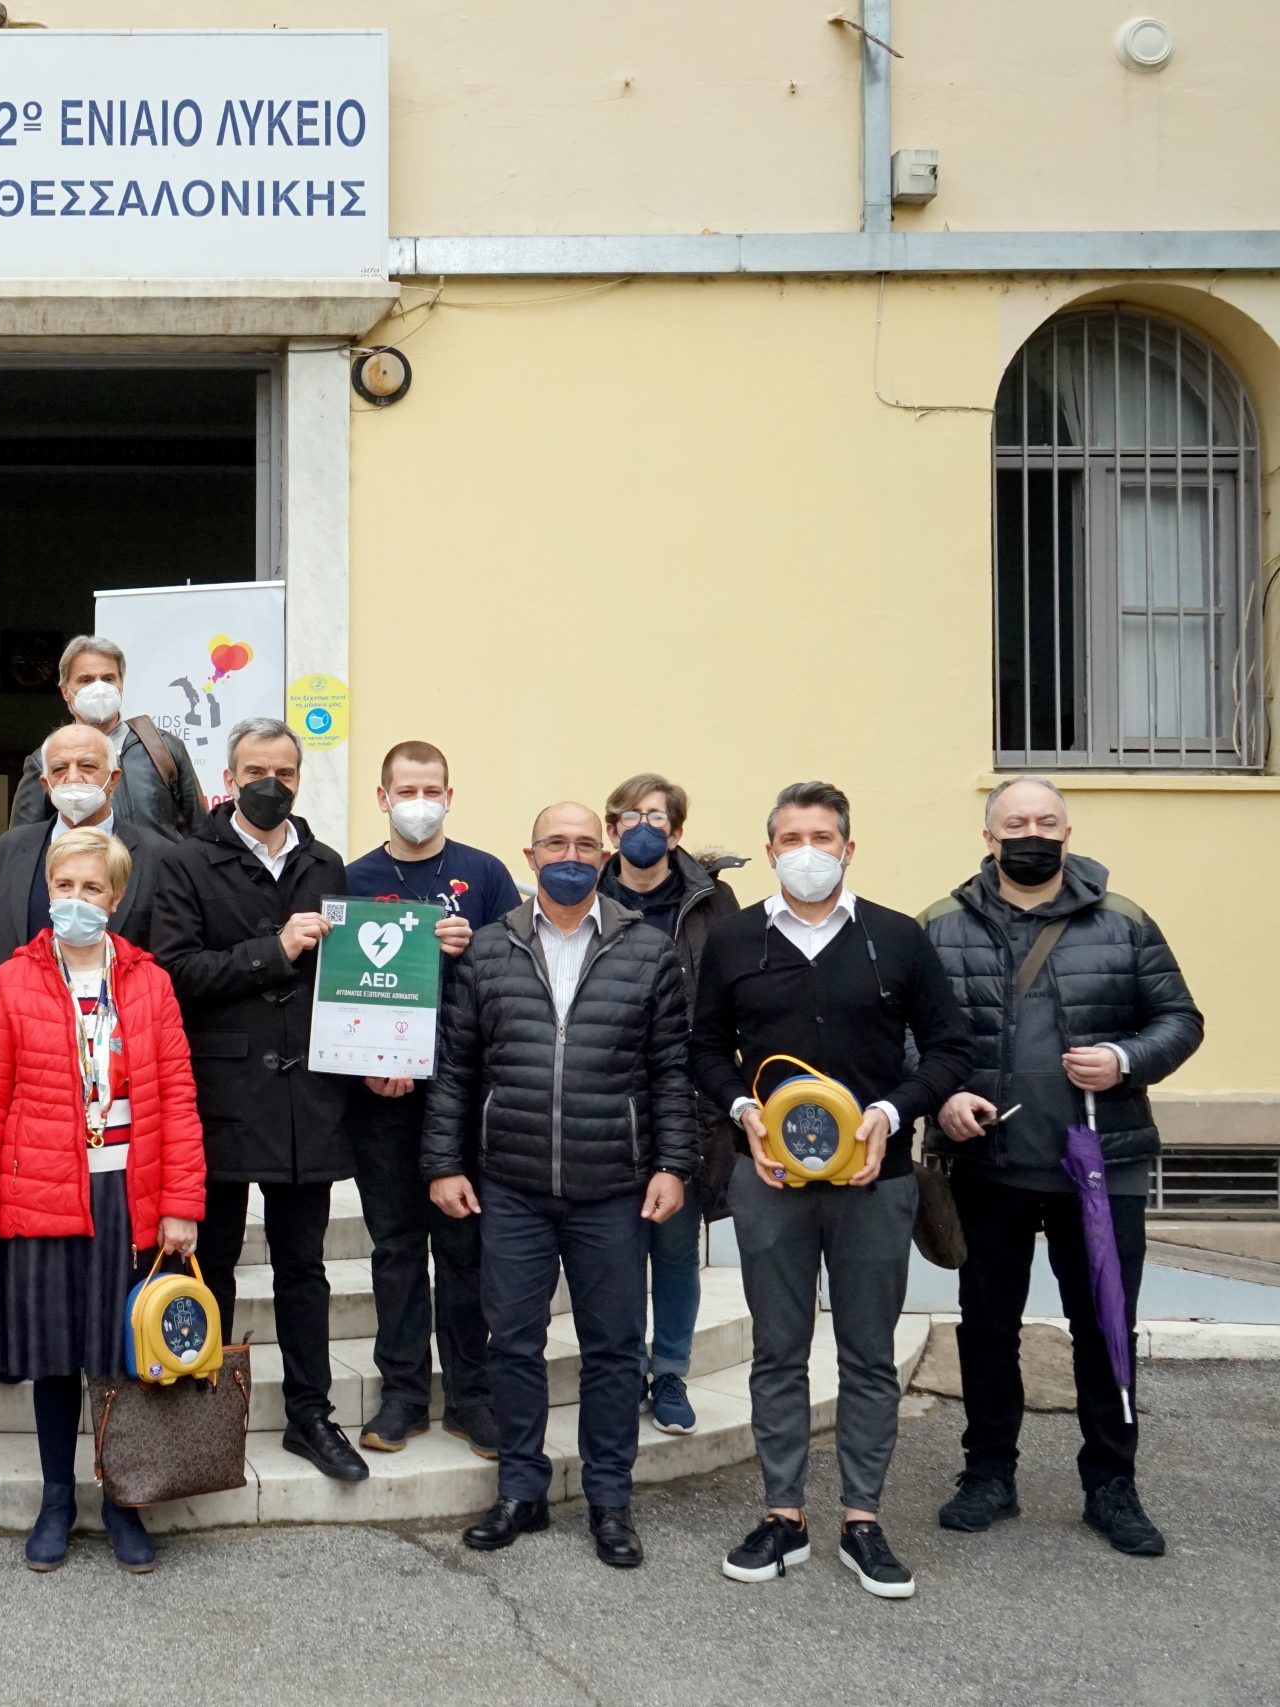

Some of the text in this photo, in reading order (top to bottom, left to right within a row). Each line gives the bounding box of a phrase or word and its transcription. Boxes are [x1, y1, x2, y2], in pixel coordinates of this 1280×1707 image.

[61, 99, 202, 147] ΕΝΙΑΙΟ
[216, 99, 366, 147] ΛΥΚΕΙΟ
[151, 715, 181, 728] IDS
[359, 971, 398, 988] AED
